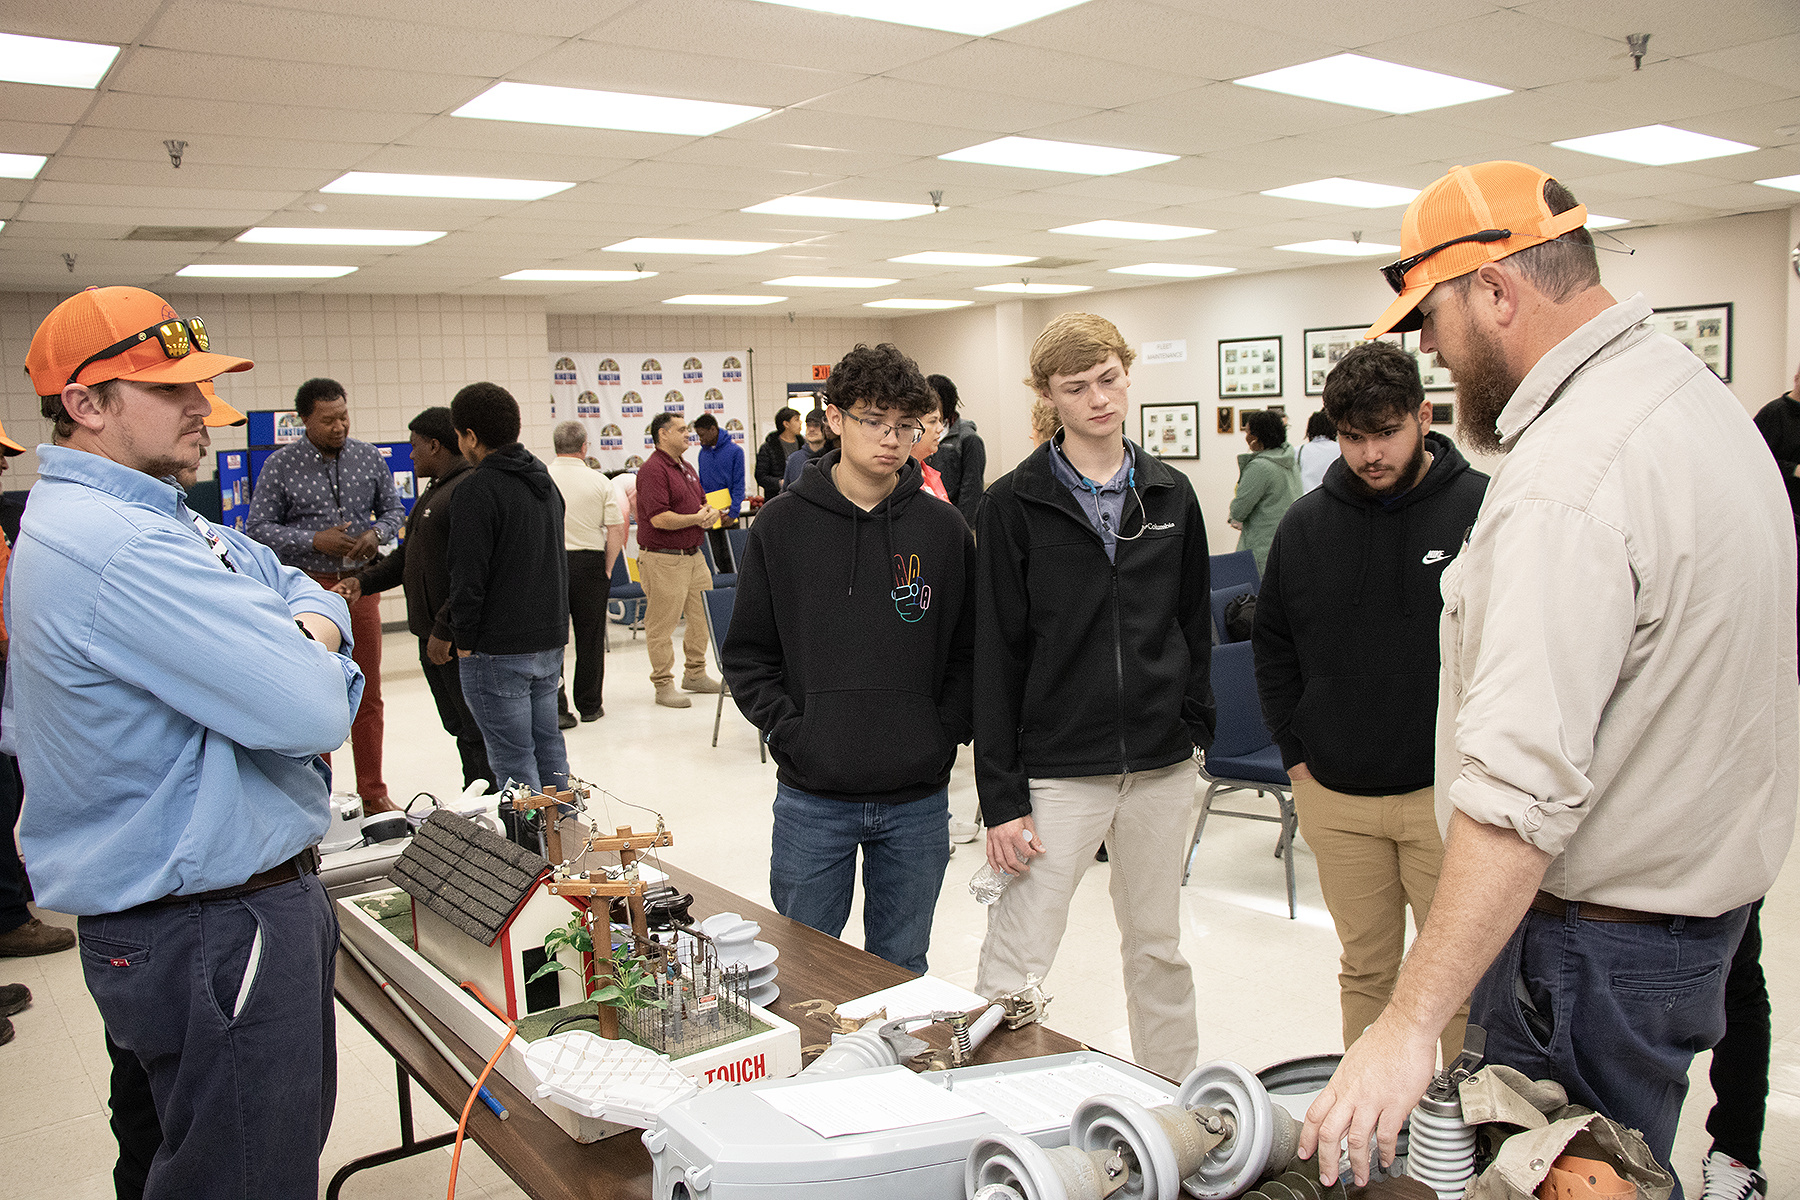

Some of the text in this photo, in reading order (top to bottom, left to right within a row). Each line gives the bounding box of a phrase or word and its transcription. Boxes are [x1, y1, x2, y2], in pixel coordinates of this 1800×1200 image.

[1156, 342, 1173, 350] FLEET
[1147, 350, 1183, 360] MAINTENANCE
[812, 365, 830, 380] EXIT
[704, 1053, 766, 1085] TOUCH
